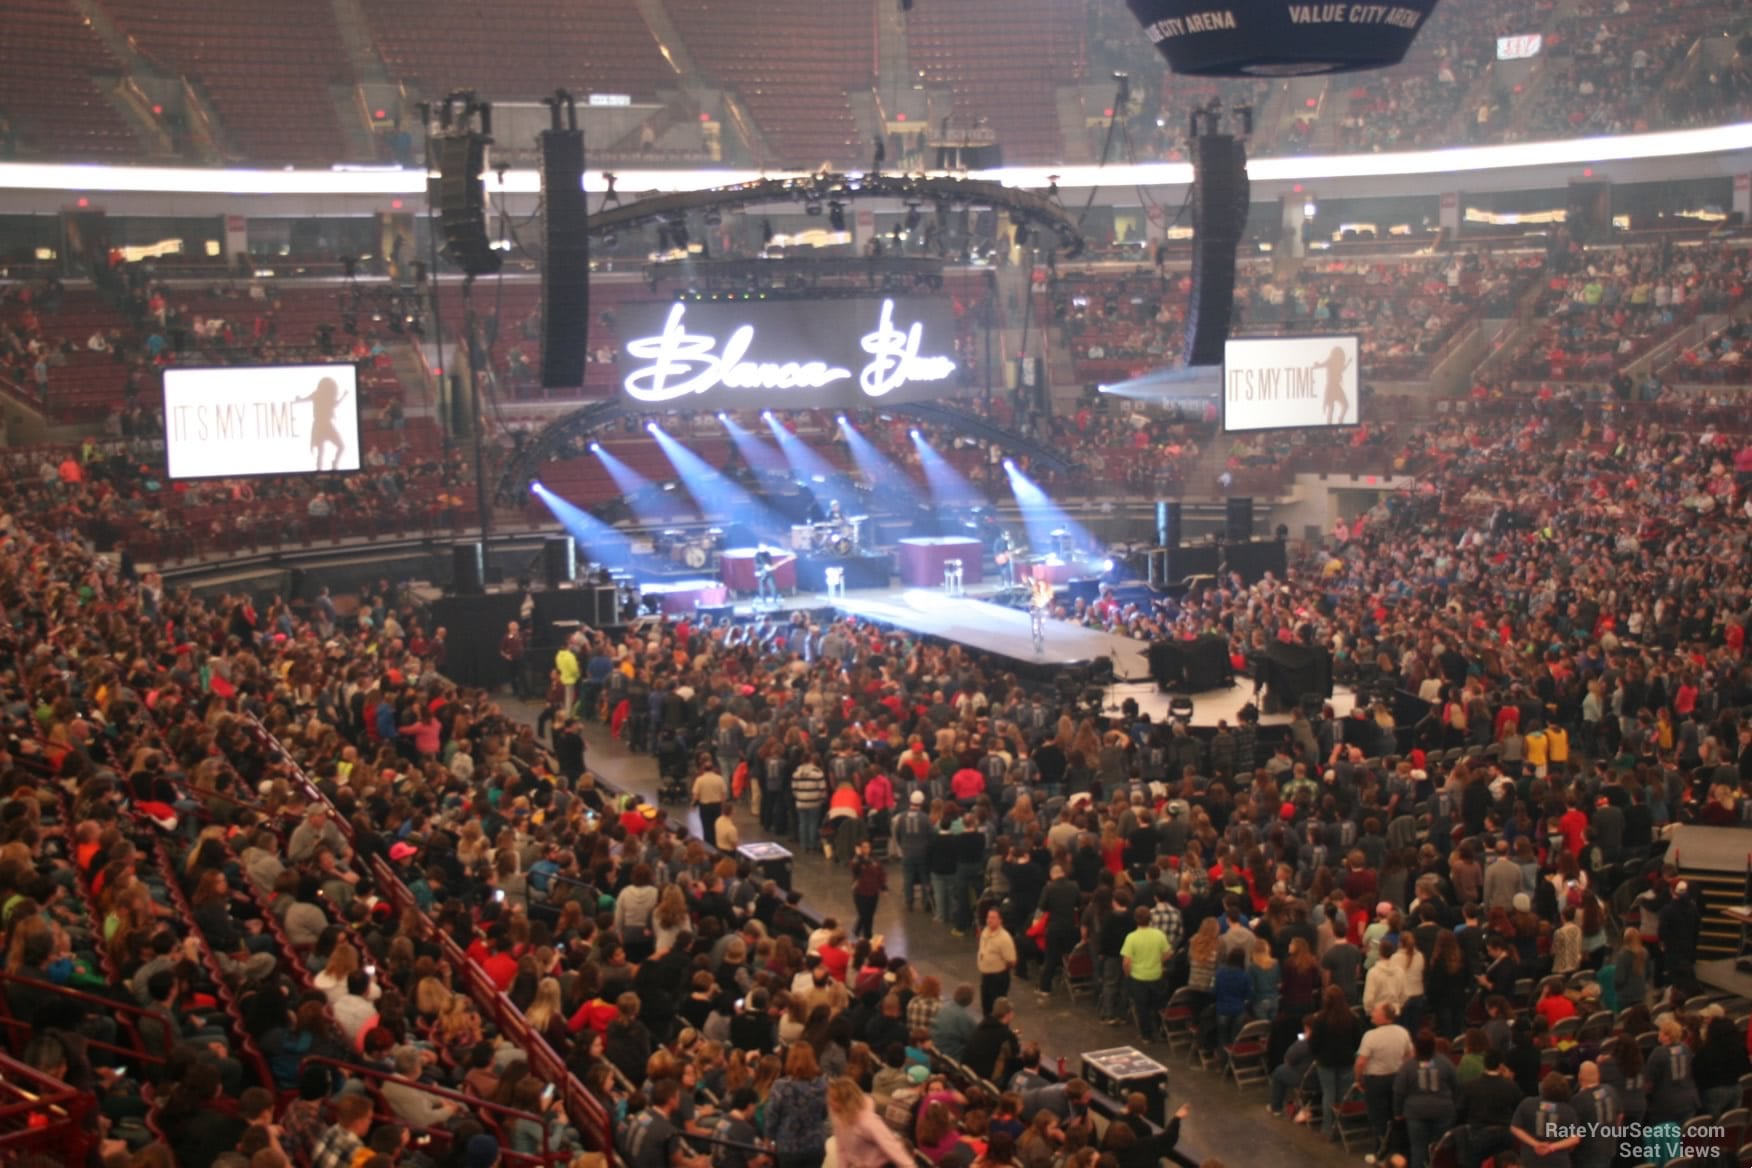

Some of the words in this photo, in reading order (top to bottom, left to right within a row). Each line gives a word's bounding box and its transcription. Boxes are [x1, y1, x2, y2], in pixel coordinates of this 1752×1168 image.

[1185, 11, 1236, 34] ARENA
[1288, 4, 1347, 24] VALUE
[1349, 5, 1386, 24] CITY
[1258, 367, 1281, 400] MY
[1284, 367, 1318, 399] TIME
[215, 402, 246, 441] MY
[252, 401, 301, 440] TIME
